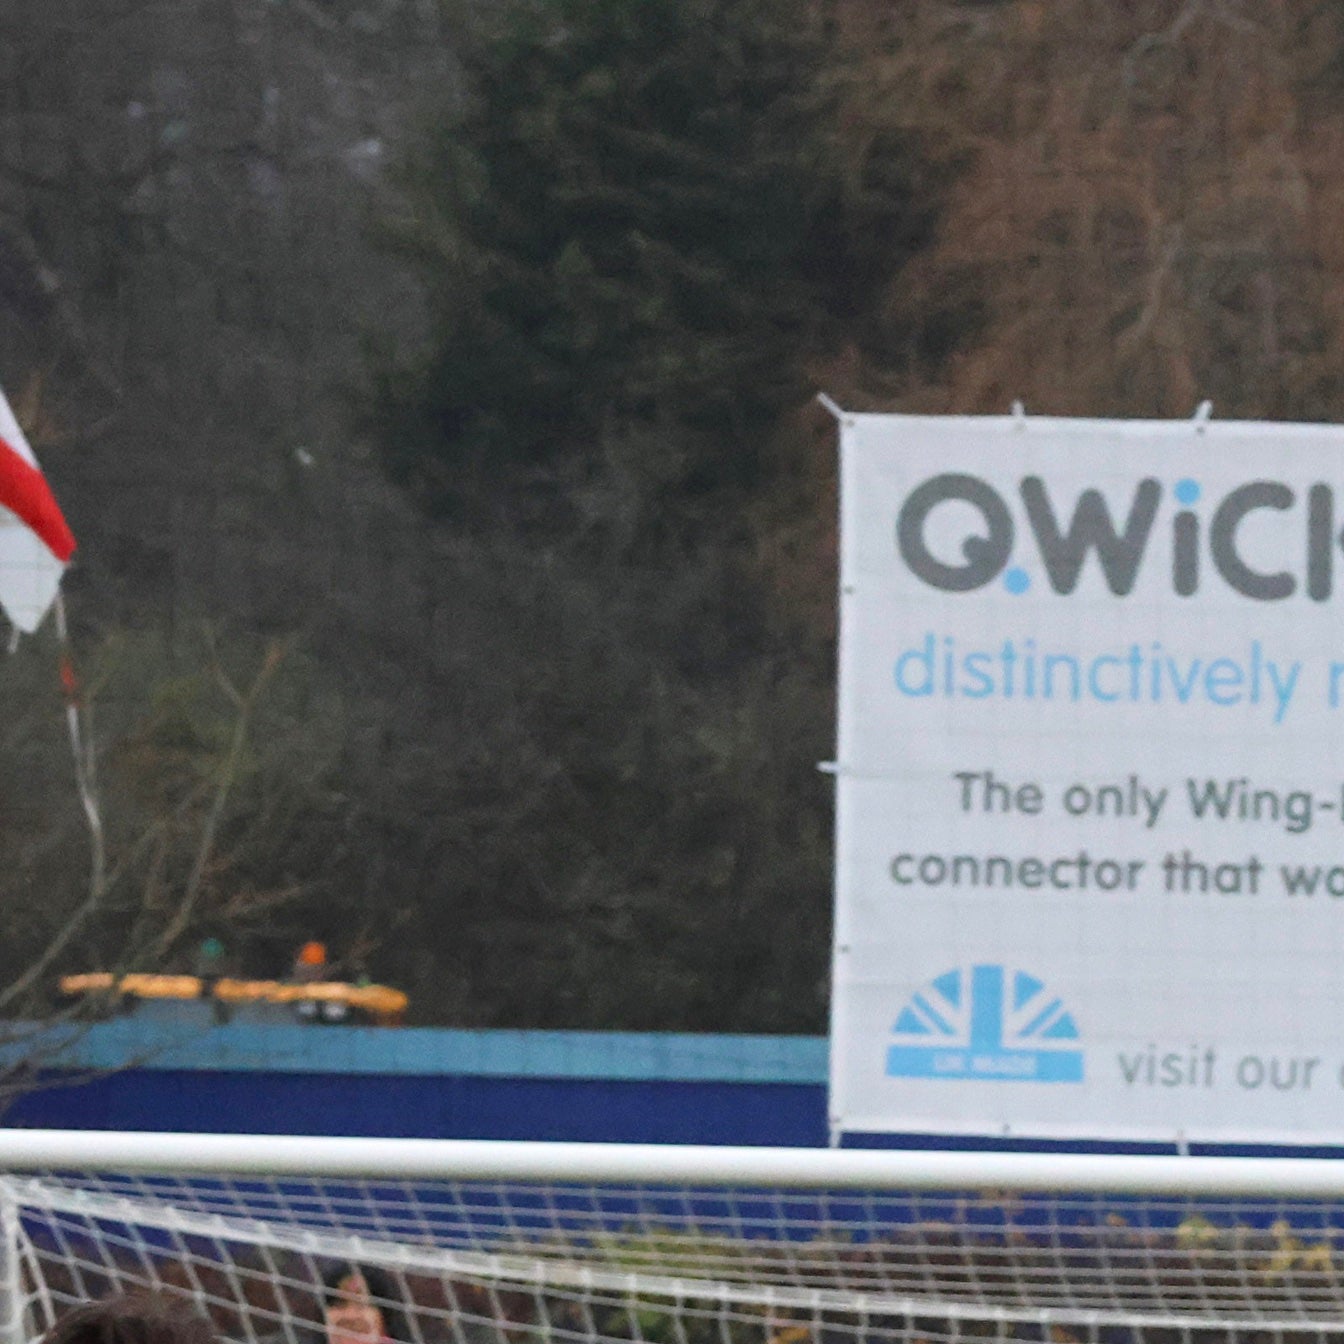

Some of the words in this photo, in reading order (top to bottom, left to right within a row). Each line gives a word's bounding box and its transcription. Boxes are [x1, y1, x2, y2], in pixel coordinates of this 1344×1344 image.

[894, 634, 1299, 724] distinctively
[954, 772, 1044, 816] The
[1063, 779, 1167, 827] only
[889, 846, 1143, 890] connector
[1162, 851, 1262, 896] that
[1118, 1045, 1218, 1089] visit
[1236, 1052, 1321, 1092] our
